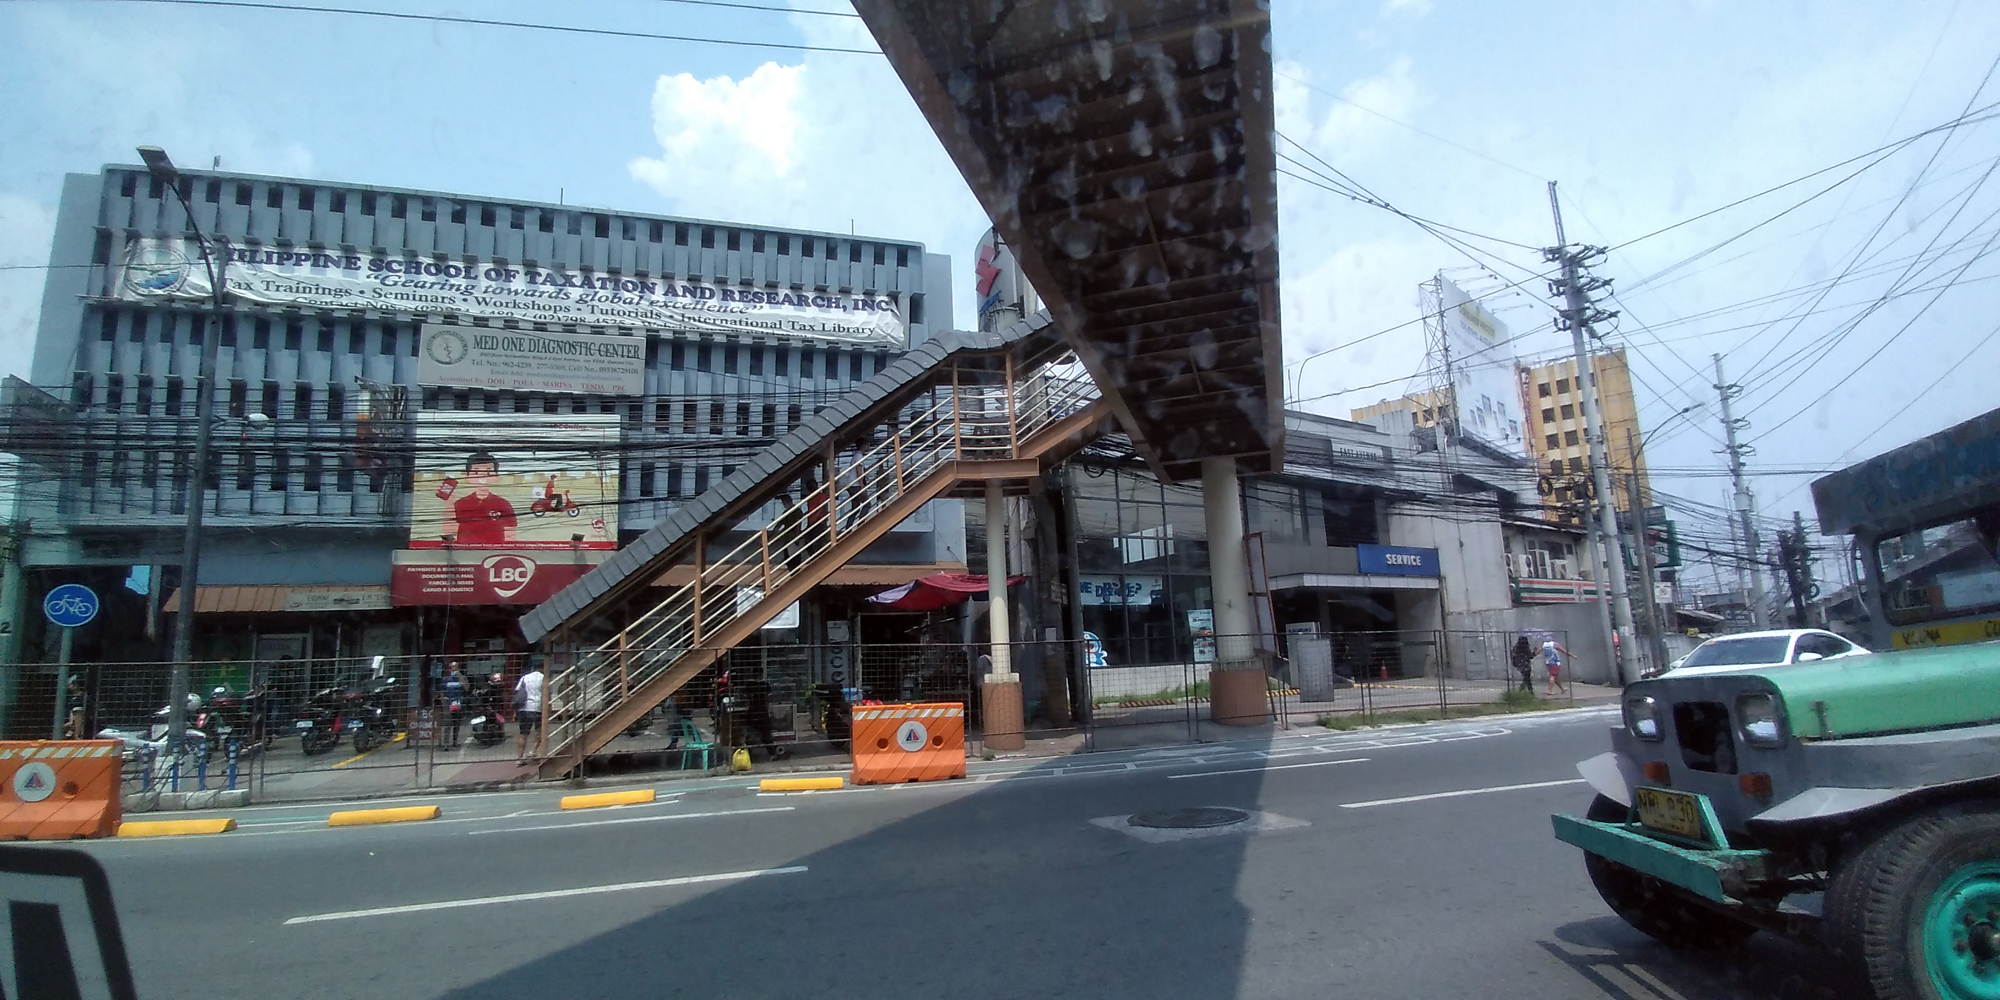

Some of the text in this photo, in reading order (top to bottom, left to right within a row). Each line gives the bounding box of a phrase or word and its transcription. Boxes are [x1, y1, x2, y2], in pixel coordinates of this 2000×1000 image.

[367, 257, 479, 281] SCHOOL
[484, 267, 520, 283] OF
[524, 269, 658, 295] TAXATION
[661, 283, 716, 300] AND
[720, 288, 848, 313] RESEARCH,
[482, 283, 572, 301] towards
[575, 288, 646, 306] global
[261, 279, 352, 299] Trainings
[372, 286, 456, 305] Seminars
[473, 295, 571, 314] Workshops
[587, 303, 662, 320] Tutorials
[681, 311, 783, 330] International
[787, 319, 817, 332] Tax
[822, 321, 876, 337] Library
[473, 334, 499, 351] MED
[502, 336, 526, 353] ONE
[528, 338, 596, 357] DIAGNOSTIC
[598, 342, 641, 360] CENTER
[1385, 553, 1422, 566] SERVICE
[489, 567, 527, 582] LBC
